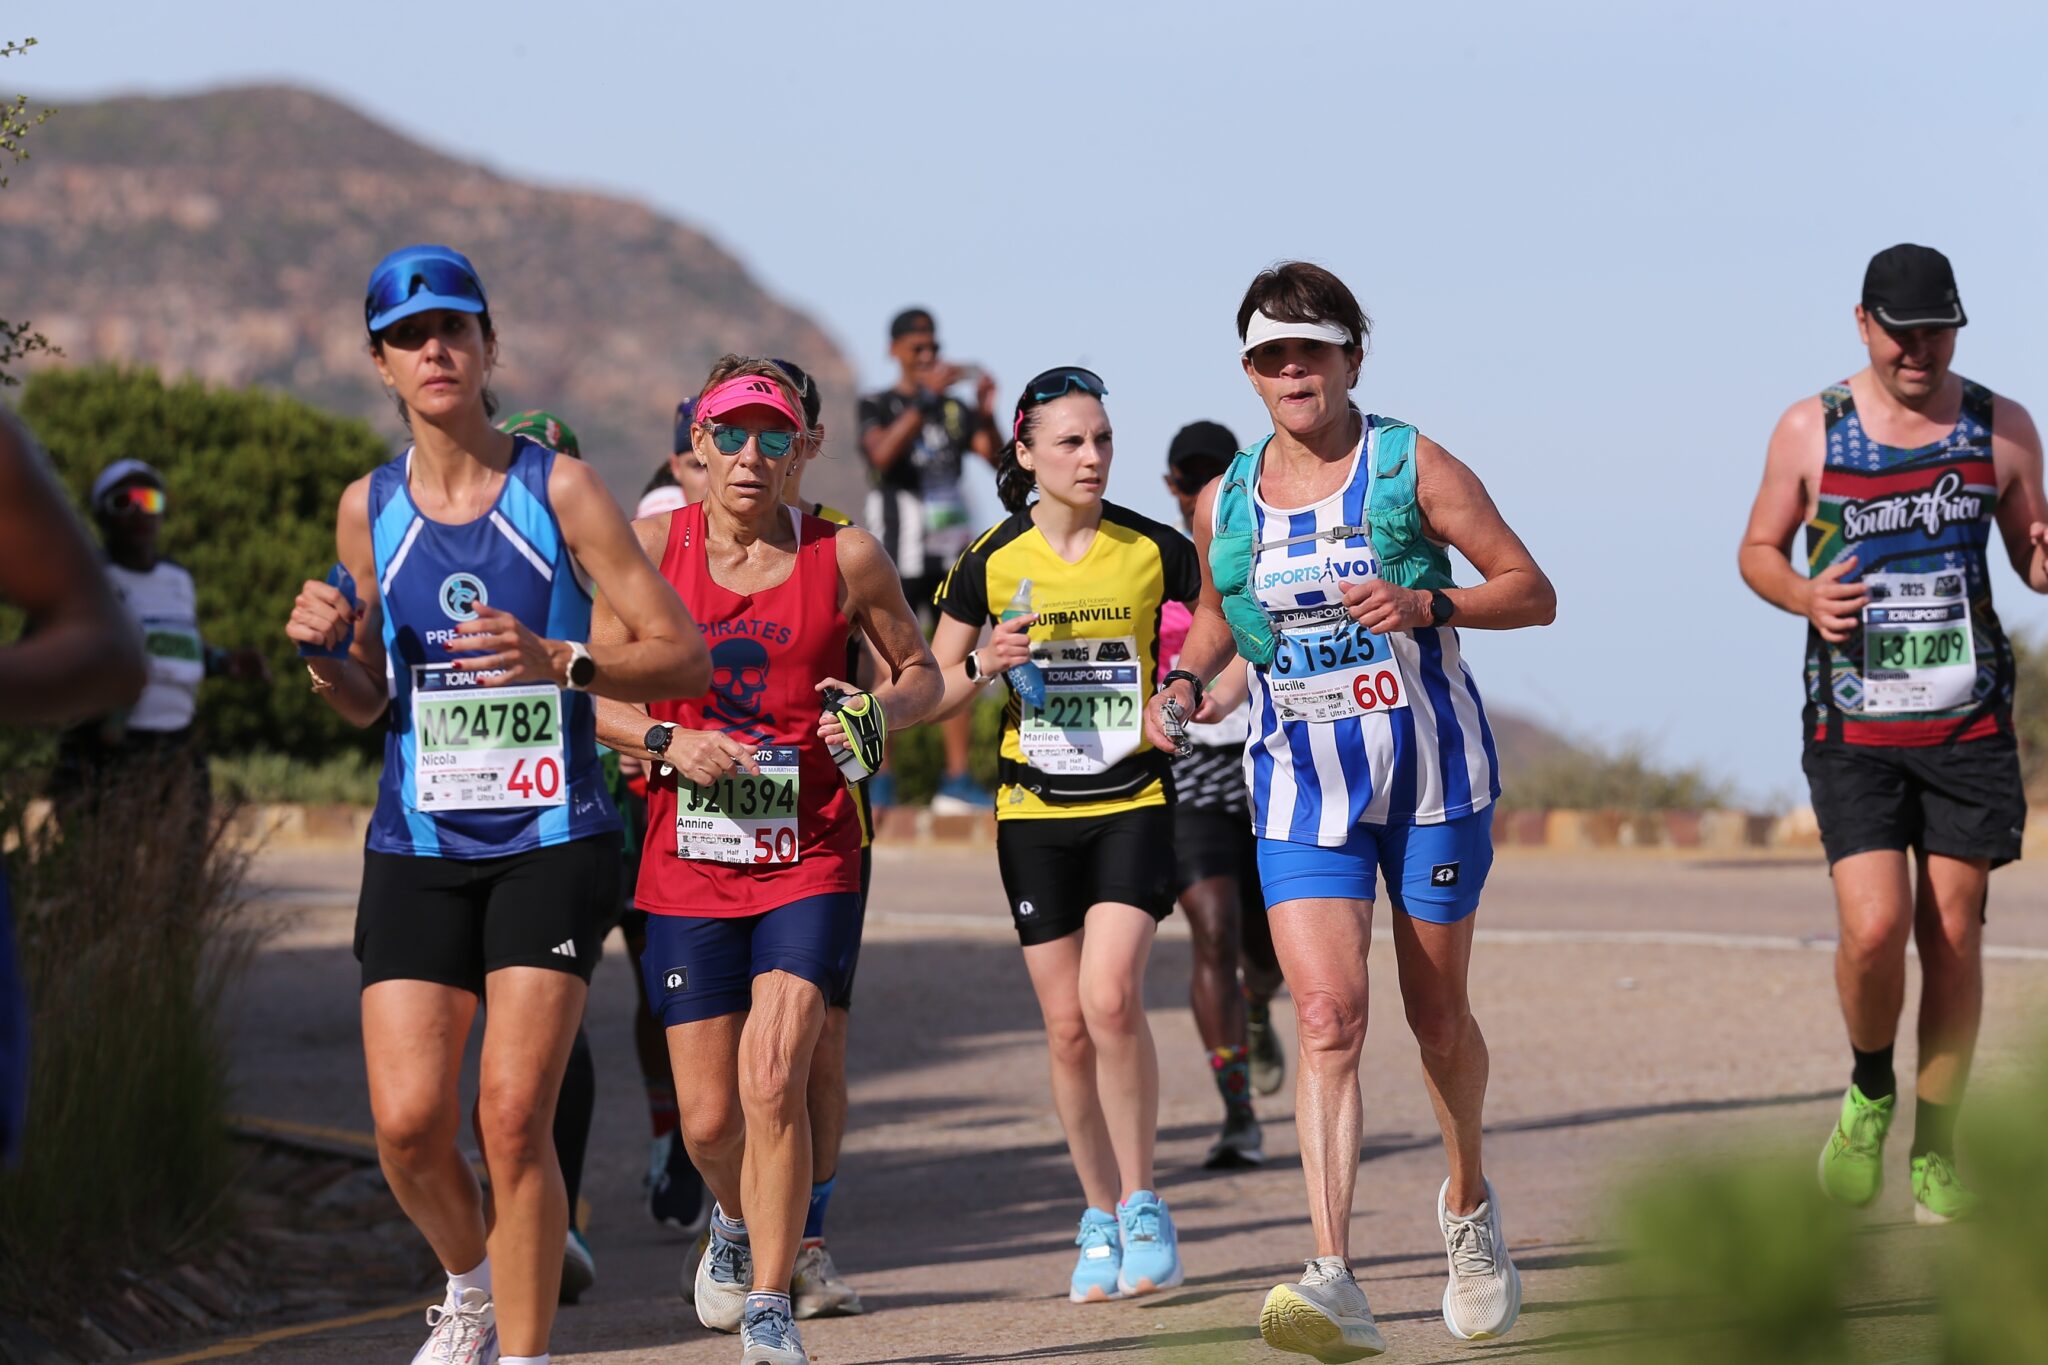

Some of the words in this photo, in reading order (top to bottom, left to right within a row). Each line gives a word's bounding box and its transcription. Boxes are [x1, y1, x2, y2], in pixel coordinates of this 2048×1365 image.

[1843, 497, 1909, 539] South
[1907, 473, 1981, 534] Africa
[1887, 608, 1949, 622] TOTALSPORTS
[697, 619, 791, 645] PIRATES
[1062, 647, 1090, 661] 2025
[1101, 643, 1126, 654] ASA
[1876, 631, 1964, 666] J31209
[1048, 669, 1113, 681] TOTALSPORTS
[1272, 680, 1306, 692] Lucille
[1353, 670, 1399, 710] 60
[1327, 702, 1342, 710] Half
[1330, 709, 1347, 718] Ultra
[424, 700, 553, 747] M24782
[1024, 732, 1060, 742] Marilee
[421, 754, 457, 767] Nicola
[507, 756, 560, 800] 40
[687, 779, 795, 815] J21394
[677, 818, 714, 830] Annine
[753, 827, 797, 864] 50
